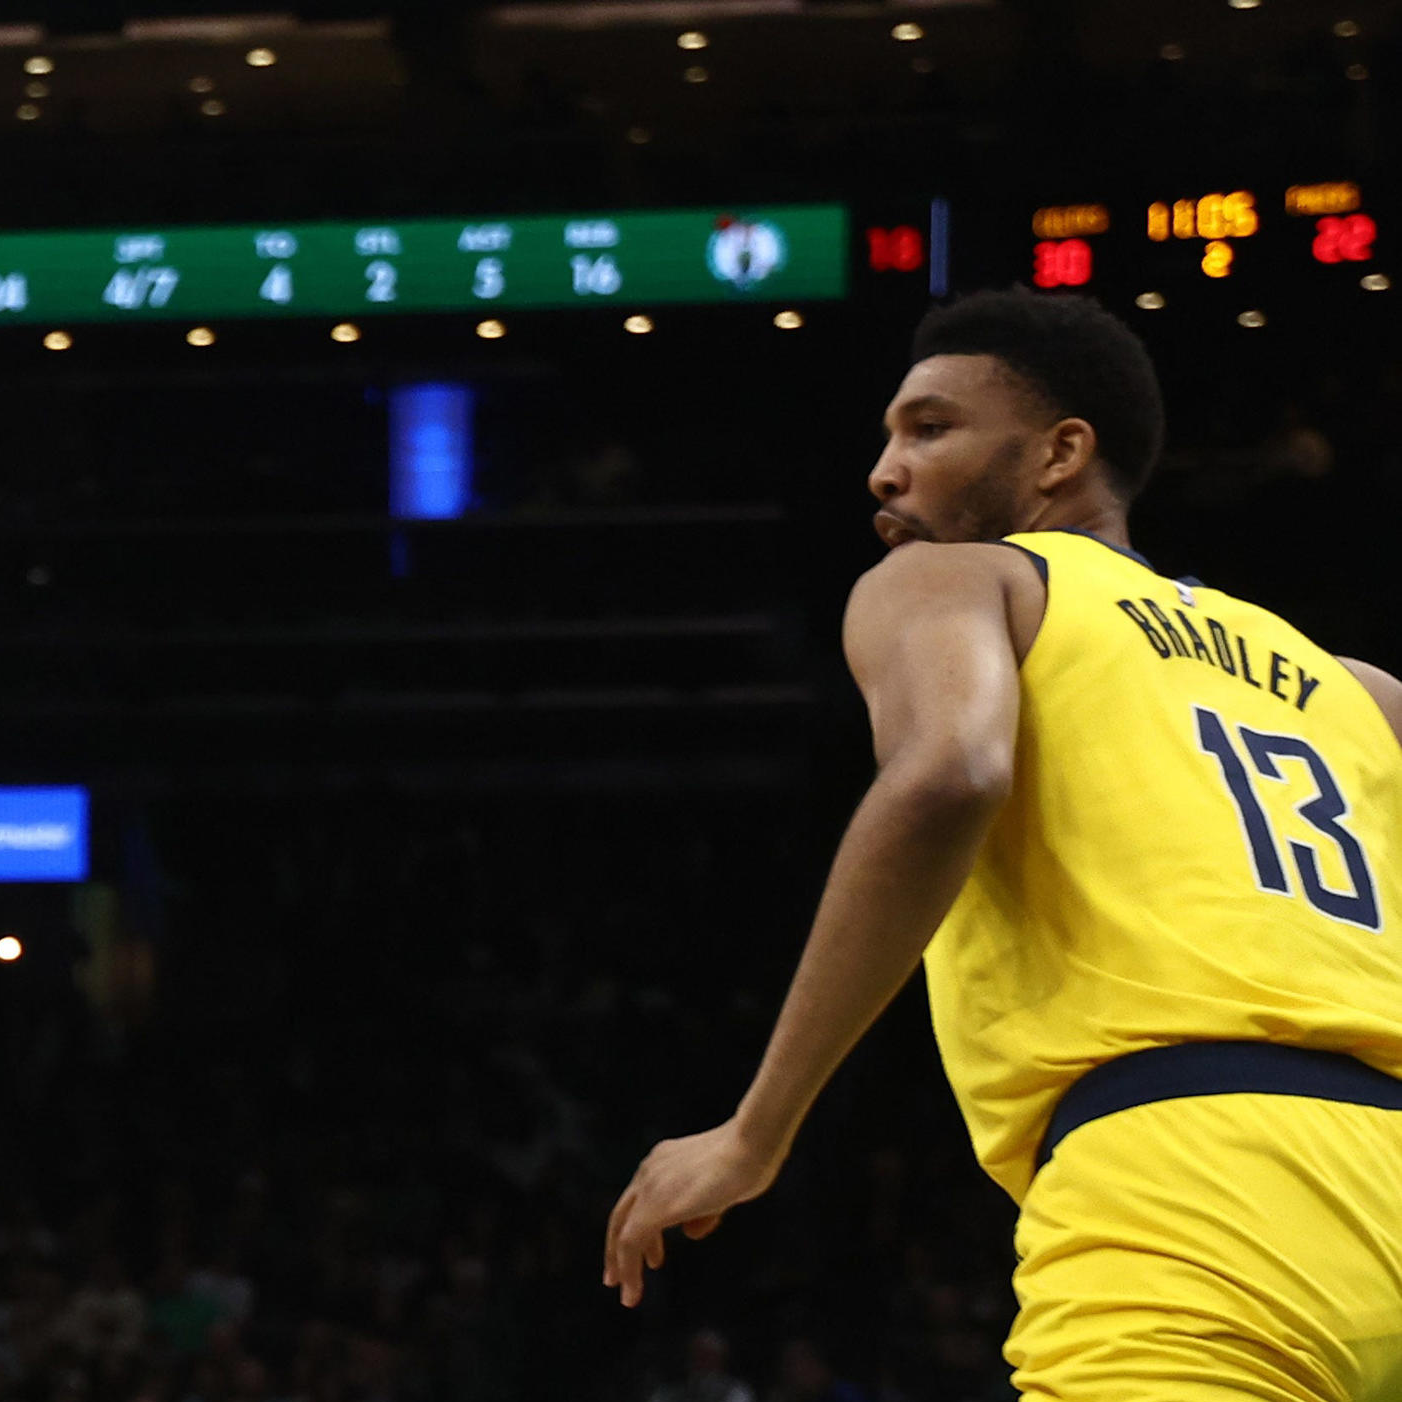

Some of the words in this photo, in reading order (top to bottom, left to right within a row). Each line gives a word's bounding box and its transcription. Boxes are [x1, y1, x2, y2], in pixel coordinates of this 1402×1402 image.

[364, 260, 398, 303] 2
[1116, 597, 1321, 712] BRADLEY
[1191, 703, 1383, 934] 13
